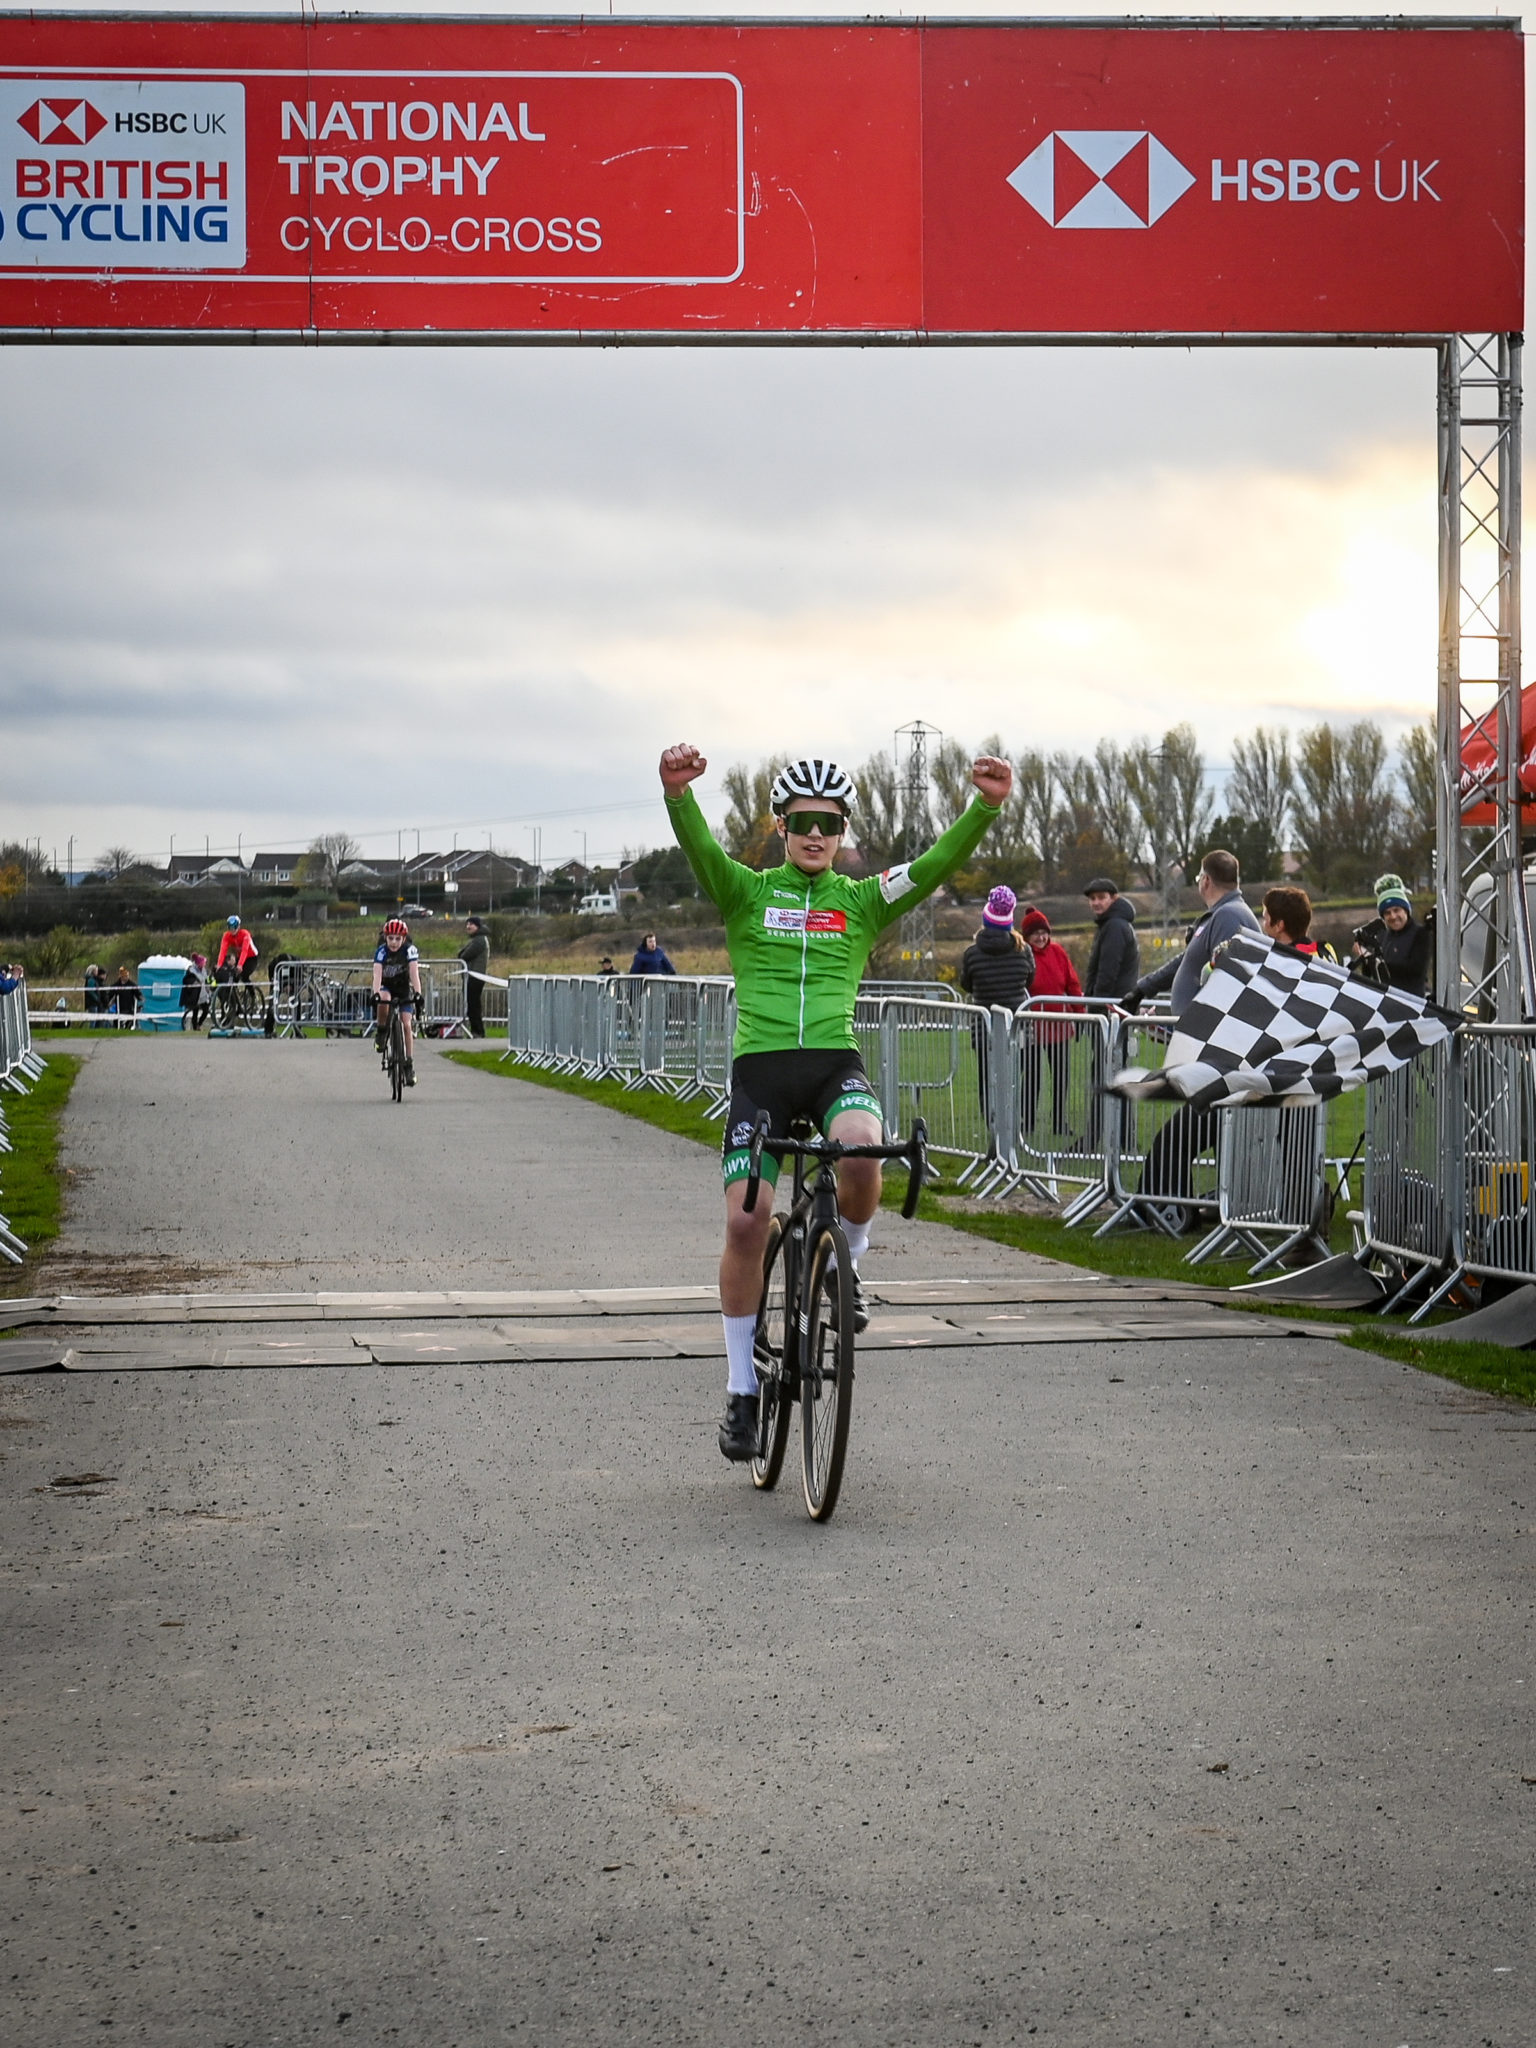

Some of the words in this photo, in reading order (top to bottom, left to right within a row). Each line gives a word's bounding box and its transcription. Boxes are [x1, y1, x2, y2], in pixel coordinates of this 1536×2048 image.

[115, 112, 188, 134] HSBC
[193, 113, 227, 135] UK
[281, 100, 547, 142] NATIONAL
[16, 158, 229, 201] BRITISH
[278, 155, 501, 197] TROPHY
[1211, 158, 1361, 203] HSBC
[1374, 159, 1443, 203] UK
[16, 203, 229, 243] CYCLING
[280, 215, 603, 253] CYCLO-CROSS
